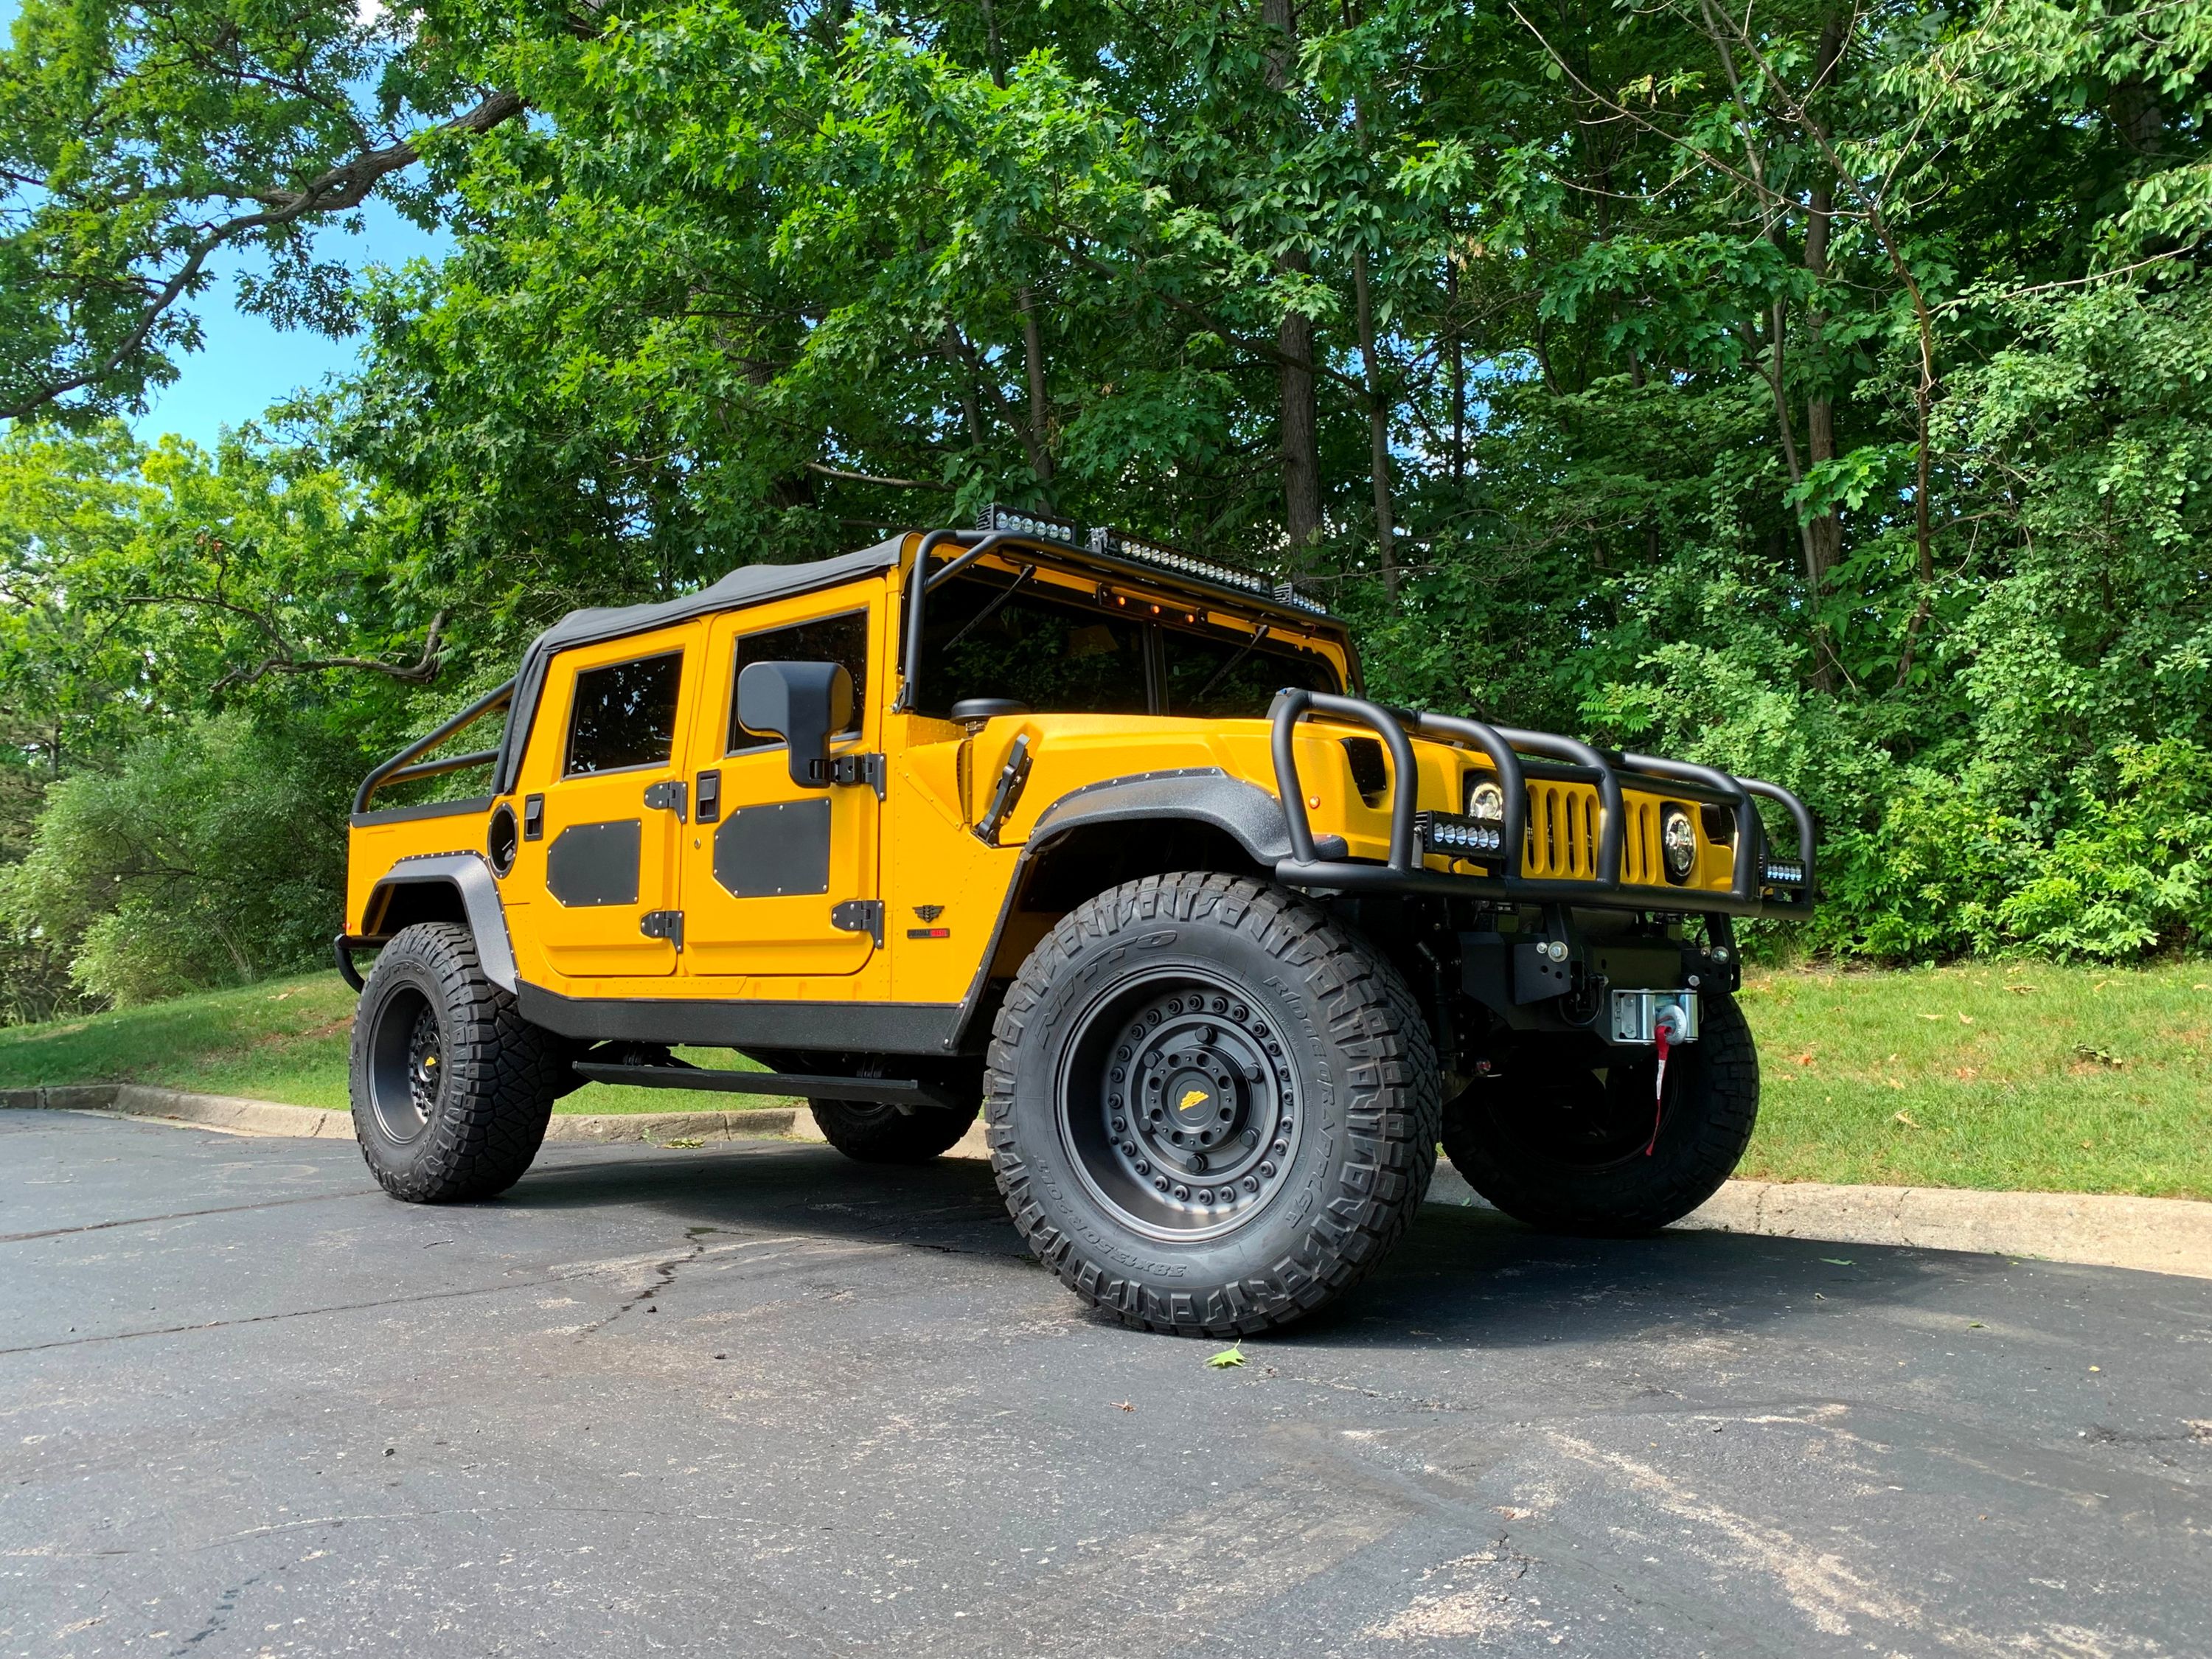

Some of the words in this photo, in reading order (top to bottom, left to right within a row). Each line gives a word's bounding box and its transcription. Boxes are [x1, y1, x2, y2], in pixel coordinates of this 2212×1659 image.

[1036, 930, 1178, 1049] NITTO
[1262, 975, 1327, 1057] RIDGE
[1287, 1062, 1335, 1229] GRAPPLER
